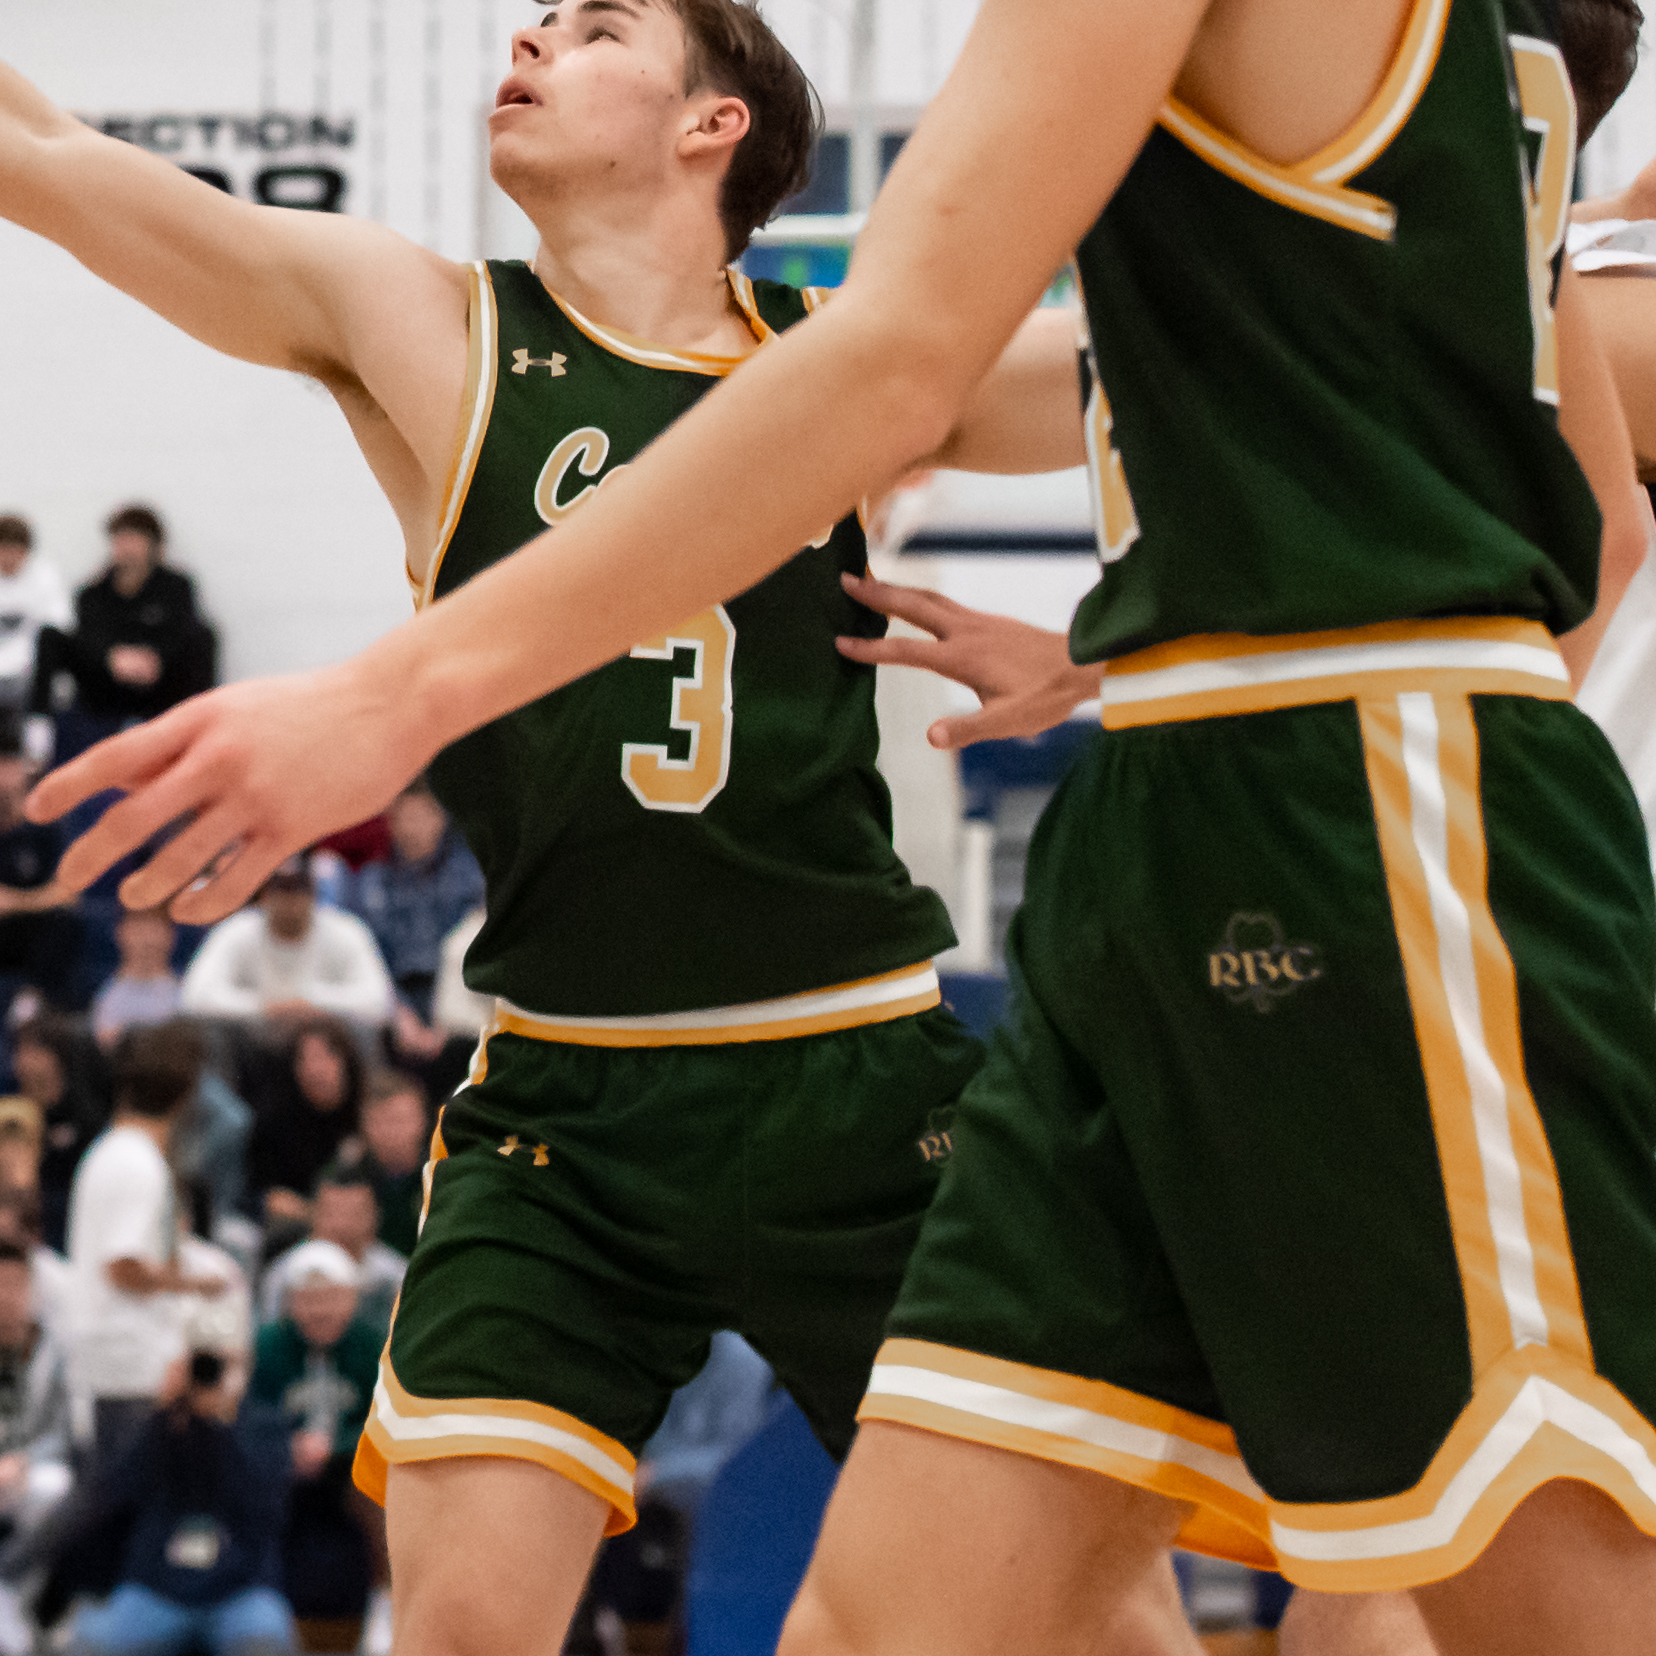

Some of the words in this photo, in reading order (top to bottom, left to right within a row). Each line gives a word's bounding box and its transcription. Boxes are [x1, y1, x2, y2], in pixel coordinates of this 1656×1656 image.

[76, 114, 358, 150] ECTION
[620, 602, 736, 813] 3
[1208, 946, 1322, 987] RBC
